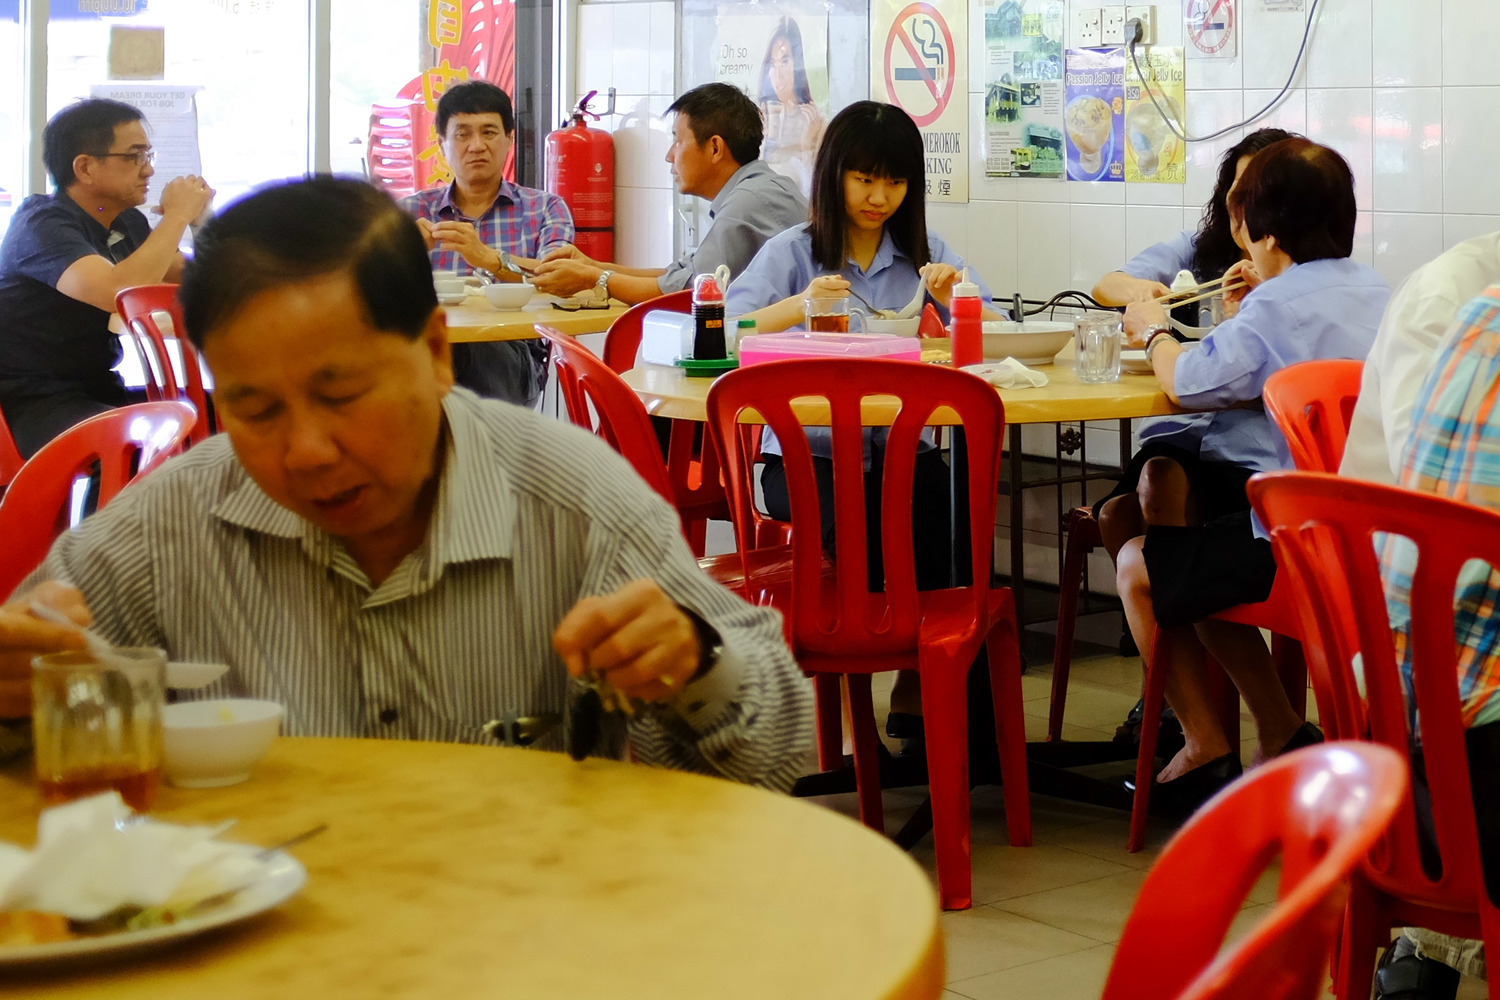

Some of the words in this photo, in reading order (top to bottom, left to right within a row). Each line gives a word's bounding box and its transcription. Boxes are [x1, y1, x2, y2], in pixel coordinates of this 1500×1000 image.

[722, 44, 735, 60] Oh
[737, 47, 748, 59] so
[1066, 72, 1093, 86] Passion
[1094, 71, 1111, 86] Jelly
[1112, 71, 1123, 85] Ice
[1171, 68, 1183, 81] Ice
[923, 132, 961, 154] MEROKOK
[925, 157, 952, 174] KING
